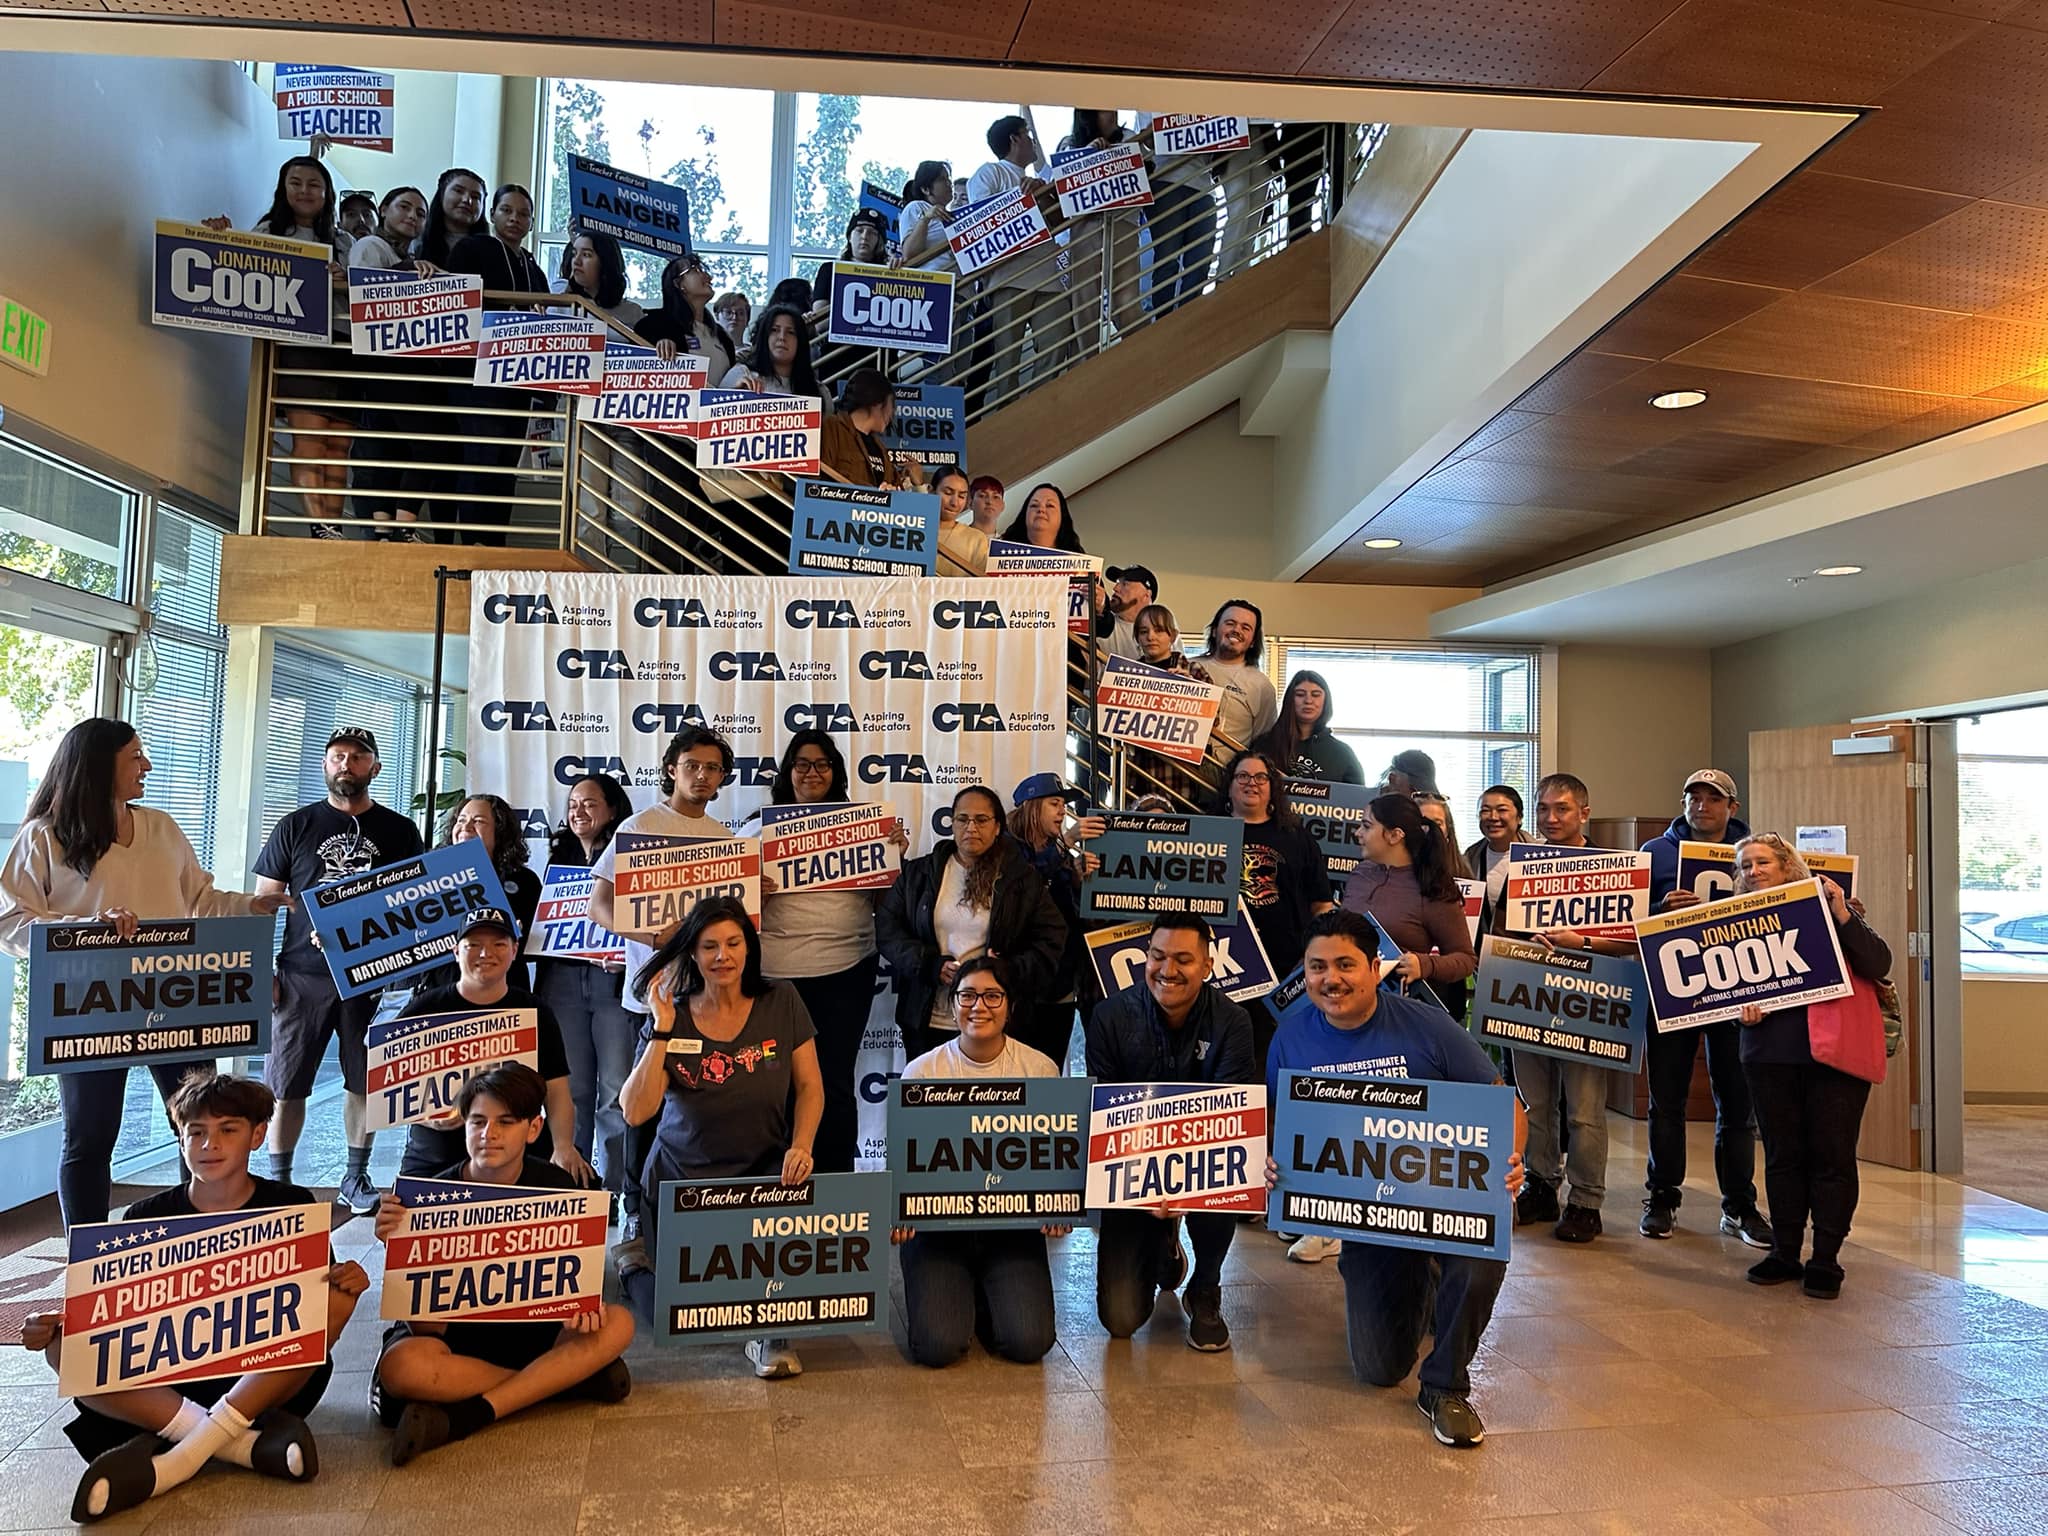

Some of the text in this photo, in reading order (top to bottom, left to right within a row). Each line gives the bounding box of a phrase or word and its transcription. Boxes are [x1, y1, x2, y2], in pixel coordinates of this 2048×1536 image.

[286, 75, 382, 88] NEVER UNDERESTIMATE
[288, 90, 381, 107] A PUBLIC SCHOOL
[288, 108, 381, 137] TEACHER
[1163, 117, 1239, 152] TEACHER
[1083, 146, 1131, 168] UNDERESTIMATE
[1073, 161, 1135, 187] PUBLIC SCHOOL
[617, 187, 679, 214] MONIQUE
[1069, 174, 1141, 213] TEACHER
[582, 187, 680, 233] LANGER
[583, 217, 682, 254] NATOMAS SCHOOL BOARD
[964, 215, 1037, 267] TEACHER
[214, 250, 290, 276] JONATHAN
[872, 282, 925, 299] JONATHAN
[2, 302, 45, 368] EXIT
[366, 314, 469, 351] TEACHER
[489, 355, 590, 383] TEACHER
[711, 400, 808, 417] NEVER UNDERESTIMATE
[710, 415, 807, 436] A PUBLIC SCHOOL
[710, 433, 807, 465] TEACHER
[820, 487, 888, 504] Teacher Endorsed
[852, 509, 926, 528] MONIQUE
[806, 517, 925, 552] LANGER
[803, 553, 922, 577] NATOMAS SCHOOL BOARD
[484, 594, 560, 624] CTA
[562, 605, 605, 617] Aspiring
[562, 617, 612, 627] Educators
[634, 598, 711, 628] CTA
[714, 609, 757, 620] Aspiring
[933, 600, 1007, 629] CTA
[1010, 609, 1050, 620] Aspiring
[714, 619, 763, 629] Educators
[1009, 620, 1056, 629] Educators
[557, 648, 634, 679] CTA
[638, 660, 680, 672] Aspiring
[638, 671, 686, 681] Educators
[860, 650, 934, 680] CTA
[936, 672, 983, 681] Educators
[937, 660, 976, 672] Aspiring
[1113, 676, 1140, 688] NEVER
[1142, 679, 1211, 698] UNDERESTIMATE
[481, 700, 557, 731] CTA
[1108, 691, 1203, 715] A PUBLIC SCHOOL
[560, 712, 603, 724] Aspiring
[560, 723, 610, 733] Educators
[1102, 708, 1199, 744] TEACHER
[1113, 817, 1187, 832] Teacher Endorsed
[1147, 840, 1227, 858] MONIQUE
[778, 843, 887, 889] TEACHER
[1099, 854, 1227, 884] LANGER
[1522, 856, 1636, 876] NEVER UNDERESTIMATE
[336, 863, 421, 900] Teacher Endorsed
[385, 867, 479, 908] MONIQUE
[1154, 882, 1167, 894] for
[1522, 873, 1634, 895] A PUBLIC SCHOOL
[336, 883, 489, 953] LANGER
[465, 908, 504, 925] NTA
[1096, 894, 1224, 913] NATOMAS SCHOOL BOARD
[1522, 895, 1633, 928] TEACHER
[1664, 920, 1674, 928] The
[1710, 904, 1732, 916] choice
[1733, 903, 1742, 911] for
[1744, 897, 1766, 909] School
[1767, 893, 1787, 904] Board
[75, 929, 122, 946] Teacher
[1699, 913, 1781, 948] JONATHAN
[131, 951, 252, 975] MONIQUE
[351, 949, 413, 983] NATOMAS
[54, 972, 253, 1016] LANGER
[1545, 972, 1632, 1001] MONIQUE
[1702, 976, 1803, 1004] NATOMAS UNIFIED SCHOOL BOARD
[1492, 979, 1632, 1029] LANGER
[52, 1025, 251, 1059] NATOMAS SCHOOL BOARD
[1487, 1019, 1626, 1059] NATOMAS BOARD
[1337, 1057, 1399, 1072] UNDERESTIMATE
[924, 1086, 1021, 1103] Teacher Endorsed
[1313, 1080, 1421, 1106] Teacher Endorsed
[1107, 1091, 1247, 1128] NEVER UNDERESTIMATE
[971, 1114, 1078, 1135] MONIQUE
[1105, 1116, 1246, 1156] A PUBLIC SCHOOL
[1364, 1117, 1488, 1148] MONIQUE
[907, 1137, 1080, 1172] LANGER
[1293, 1134, 1490, 1191] LANGER
[1105, 1145, 1247, 1203] TEACHER
[700, 1184, 809, 1206] Teacher Endorsed
[906, 1193, 1080, 1216] NATOMAS SCHOOL BOARD
[410, 1198, 587, 1232] NEVER UNDERESTIMATE
[753, 1212, 869, 1238] MONIQUE
[1290, 1196, 1362, 1224] NATOMAS
[1367, 1205, 1427, 1233] SCHOOL
[1432, 1213, 1487, 1239] BOARD
[93, 1213, 305, 1285] NEVER UNDERESTIMATE
[407, 1223, 583, 1264] A PUBLIC SCHOOL
[680, 1236, 870, 1283] LANGER
[90, 1245, 302, 1325] A PUBLIC SCHOOL
[407, 1255, 581, 1315] TEACHER
[678, 1297, 868, 1329] NATOMAS SCHOOL BOARD
[90, 1282, 301, 1387] TEACHER
[240, 1344, 302, 1368] #WeAreCTA
